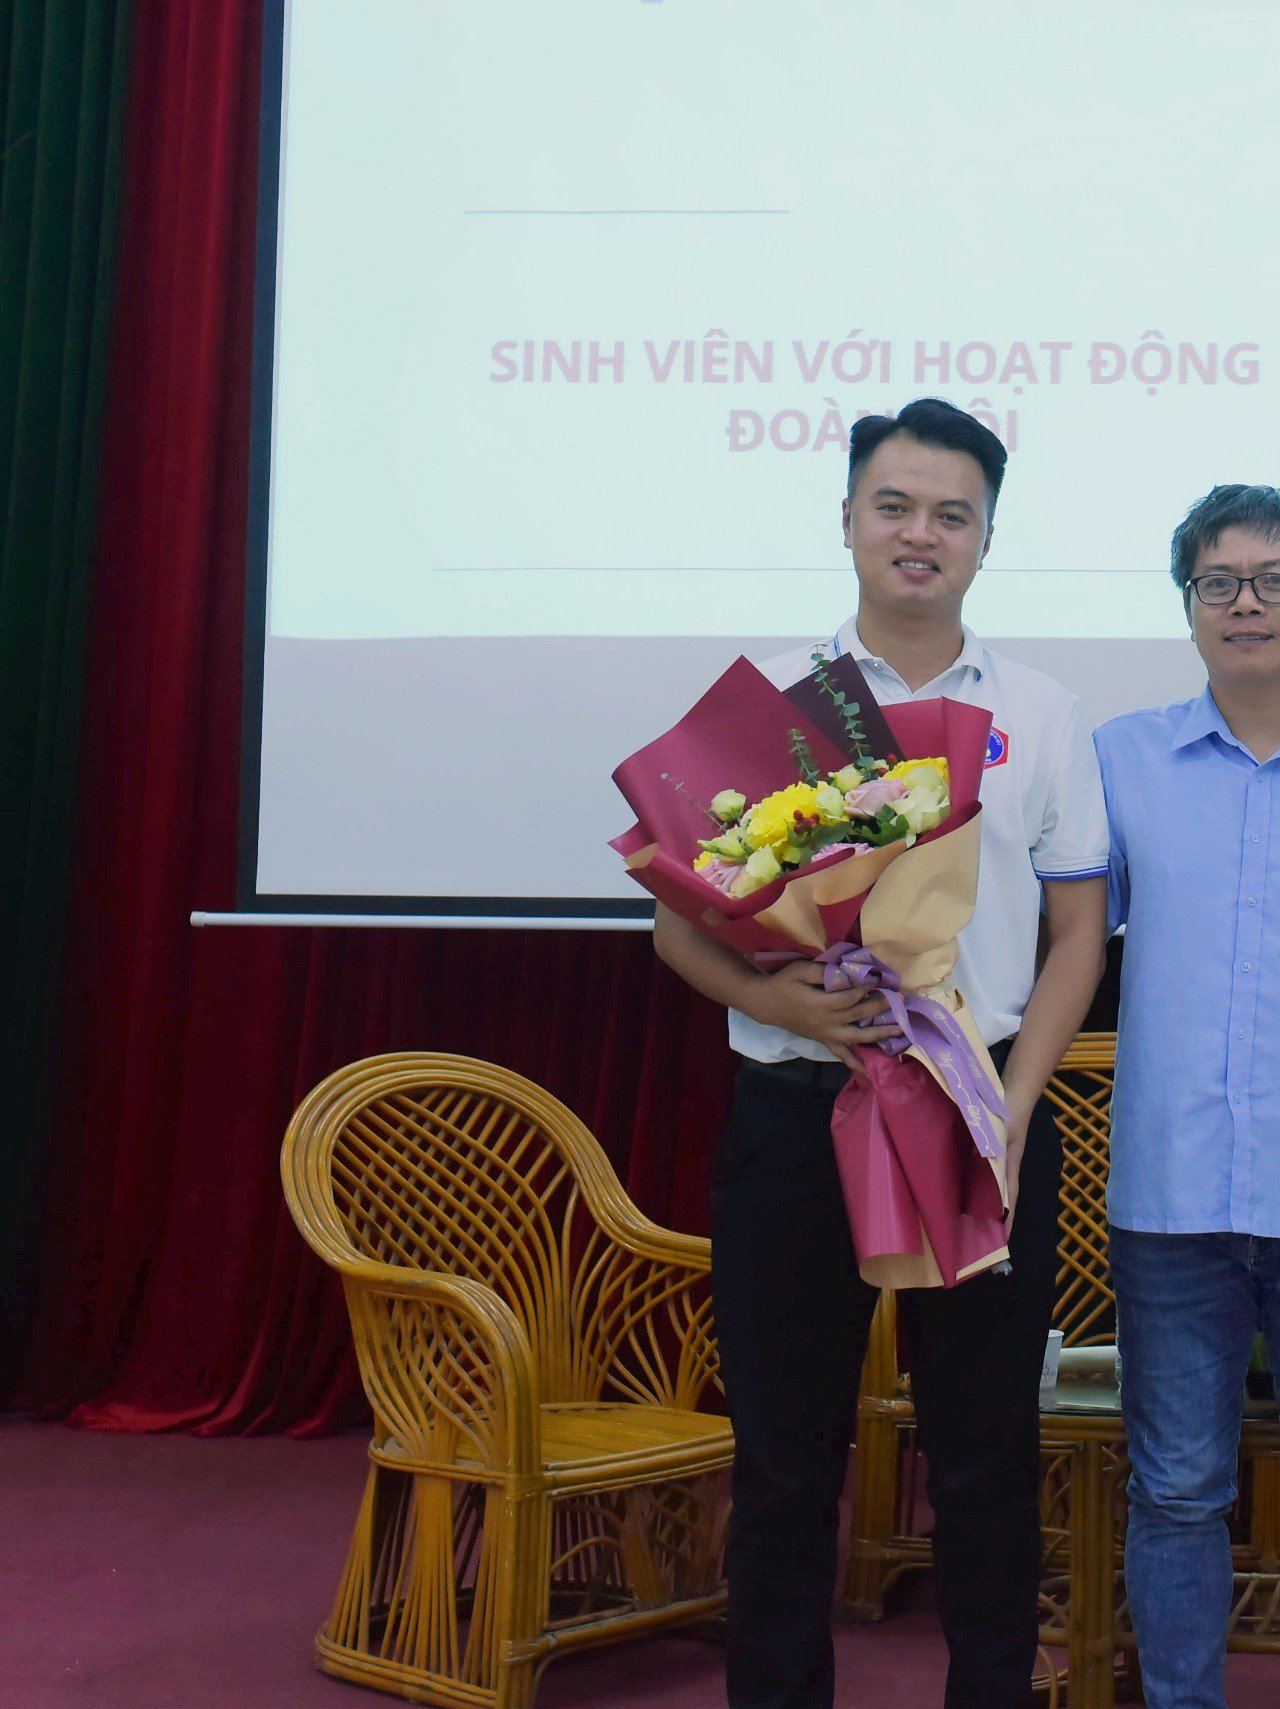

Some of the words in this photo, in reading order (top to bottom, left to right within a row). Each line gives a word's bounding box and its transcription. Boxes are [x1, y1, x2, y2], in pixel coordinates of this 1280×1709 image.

[489, 339, 625, 384] SINH
[643, 328, 774, 384] VIÊN
[792, 328, 892, 384] VỚI
[913, 340, 1073, 395] HOẠT
[1086, 329, 1261, 397] ĐỘNG
[725, 396, 895, 453] ĐOÀ
